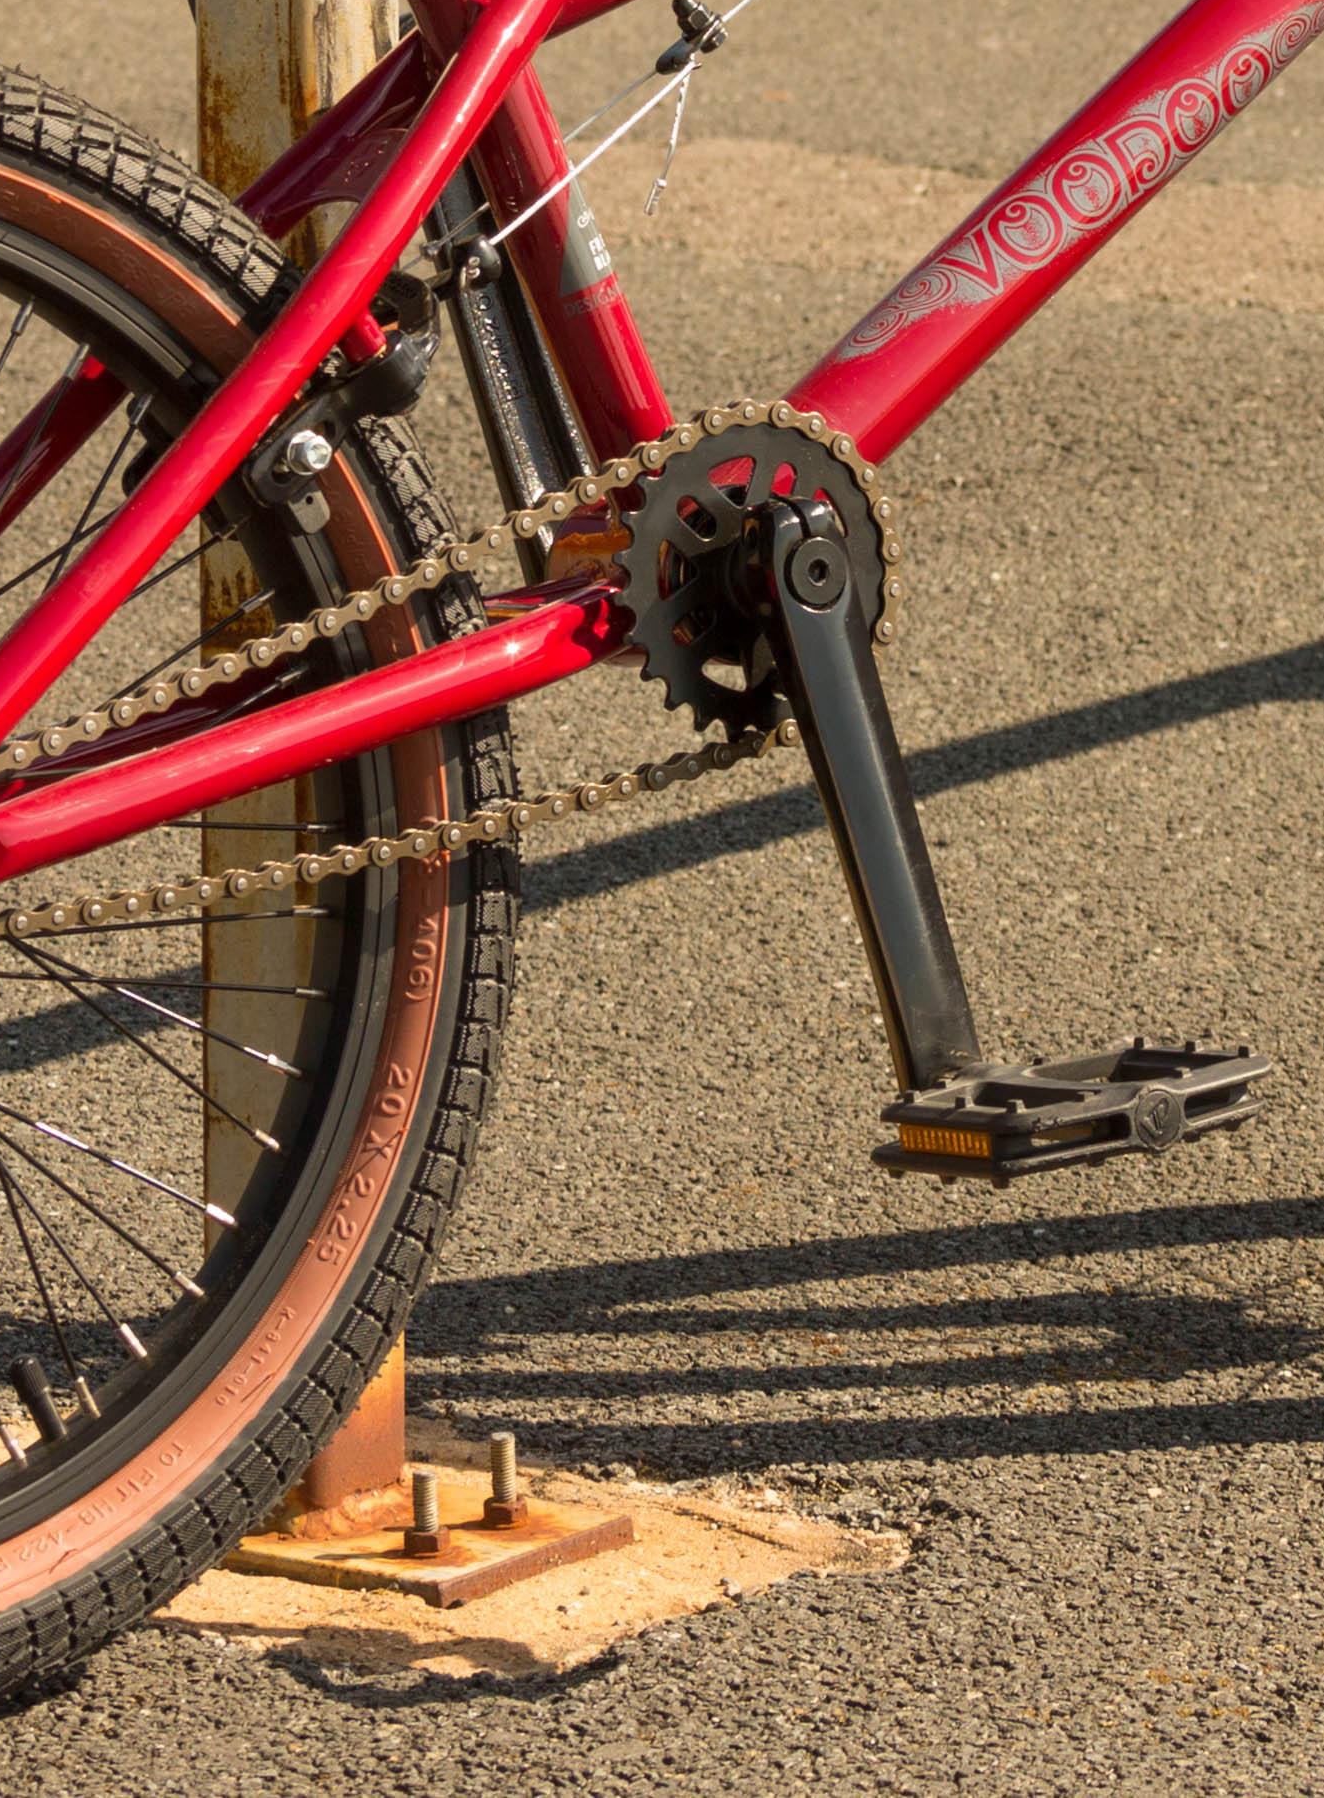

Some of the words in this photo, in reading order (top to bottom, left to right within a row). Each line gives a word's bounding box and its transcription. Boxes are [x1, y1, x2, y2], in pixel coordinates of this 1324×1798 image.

[940, 41, 1277, 294] VOODOO
[378, 1063, 414, 1118] 20
[315, 1171, 377, 1269] 2.25
[115, 1468, 156, 1504] FIT
